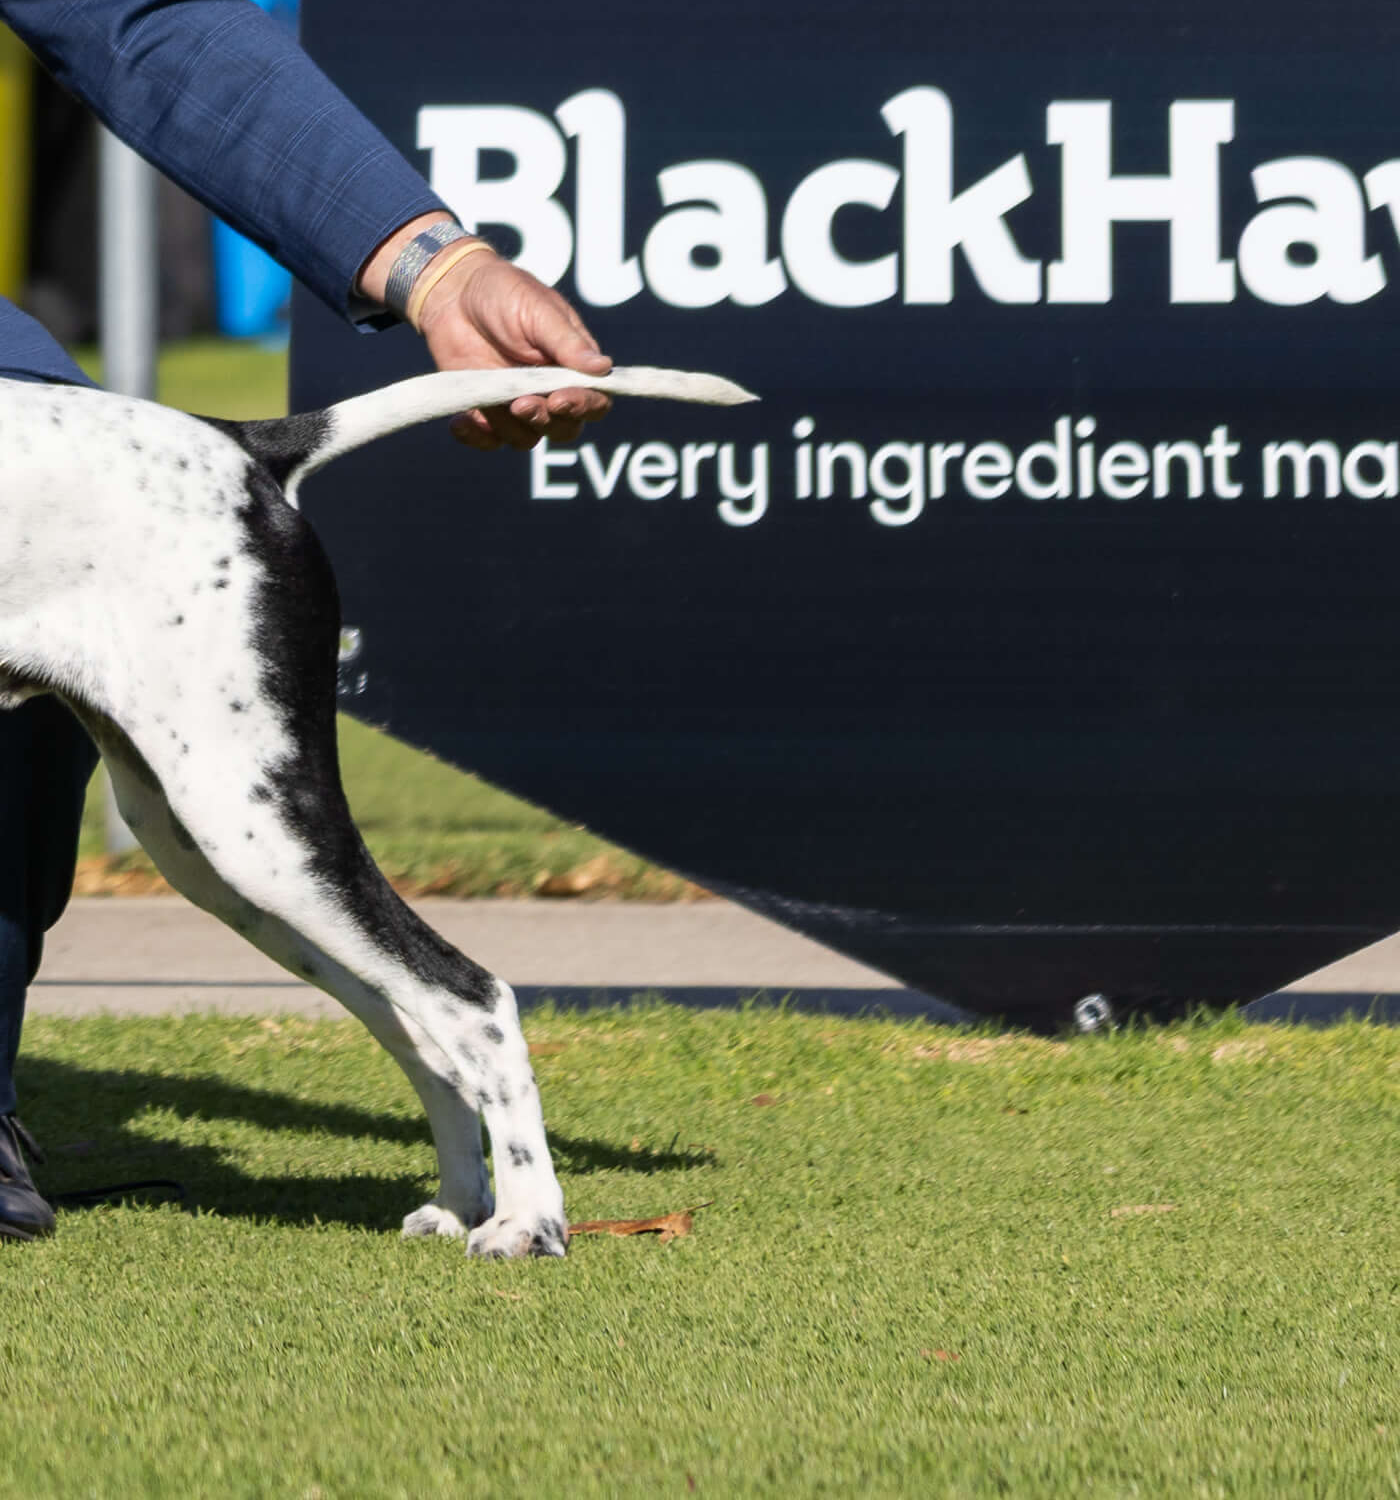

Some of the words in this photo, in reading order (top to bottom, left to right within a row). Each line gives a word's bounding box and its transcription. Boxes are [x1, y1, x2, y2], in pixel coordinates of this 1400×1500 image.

[416, 85, 1400, 308] BlackHa
[530, 434, 769, 527] Every
[792, 415, 1243, 527] ingredient
